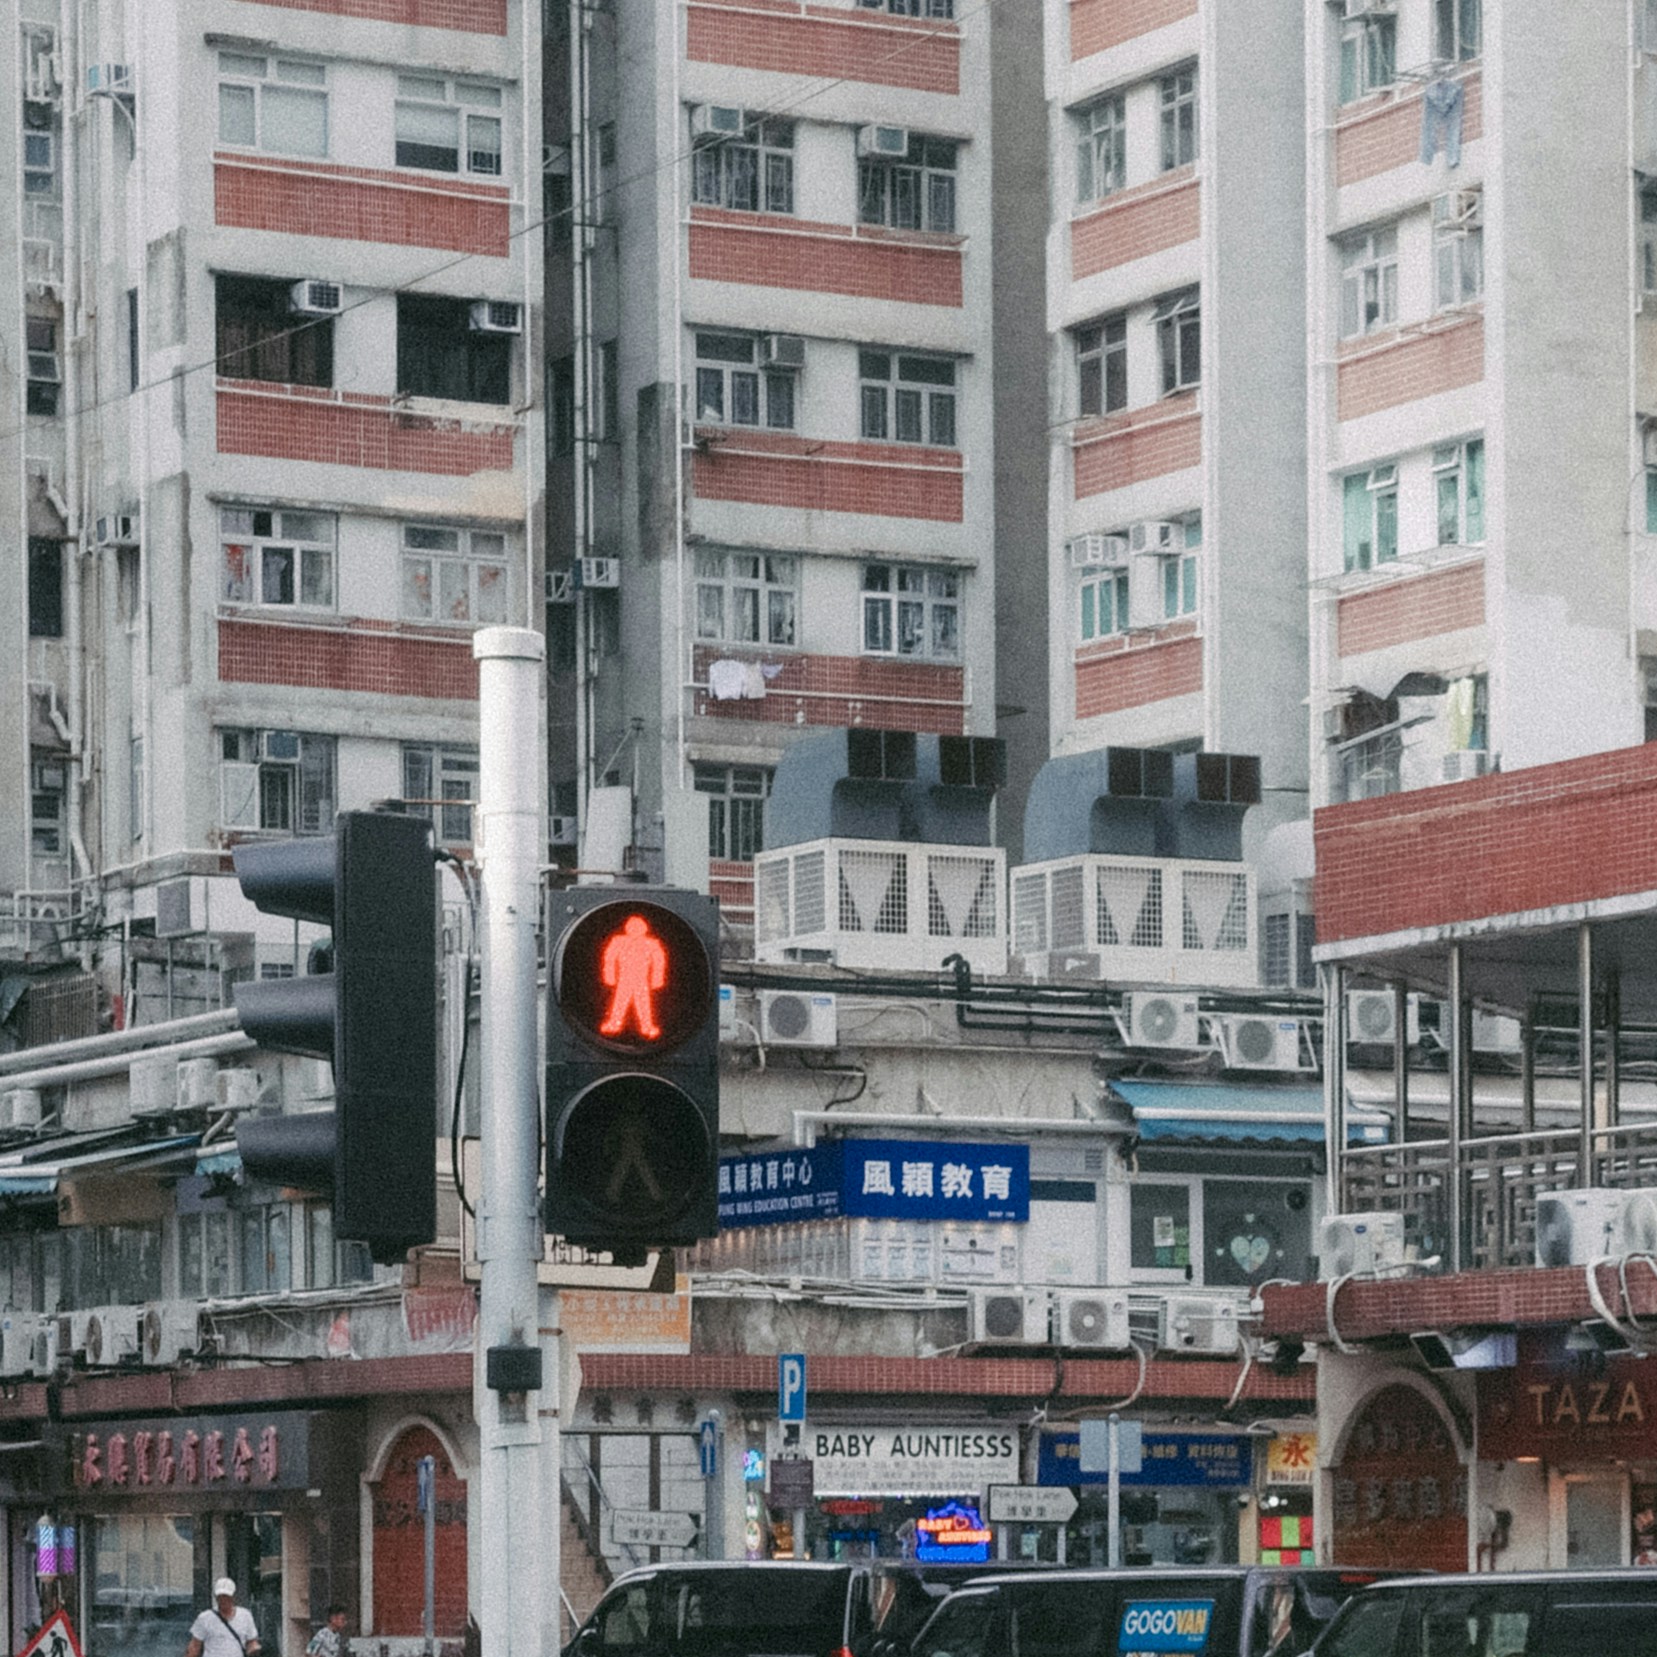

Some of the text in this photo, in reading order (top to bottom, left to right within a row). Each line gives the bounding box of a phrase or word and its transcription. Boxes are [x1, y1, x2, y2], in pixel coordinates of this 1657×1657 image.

[1527, 1381, 1645, 1426] TAZA
[83, 1424, 278, 1485] 永貿易有限公司
[815, 1433, 1013, 1458] BABY AUNTIESSS
[1124, 1608, 1209, 1635] GOGOVAN
